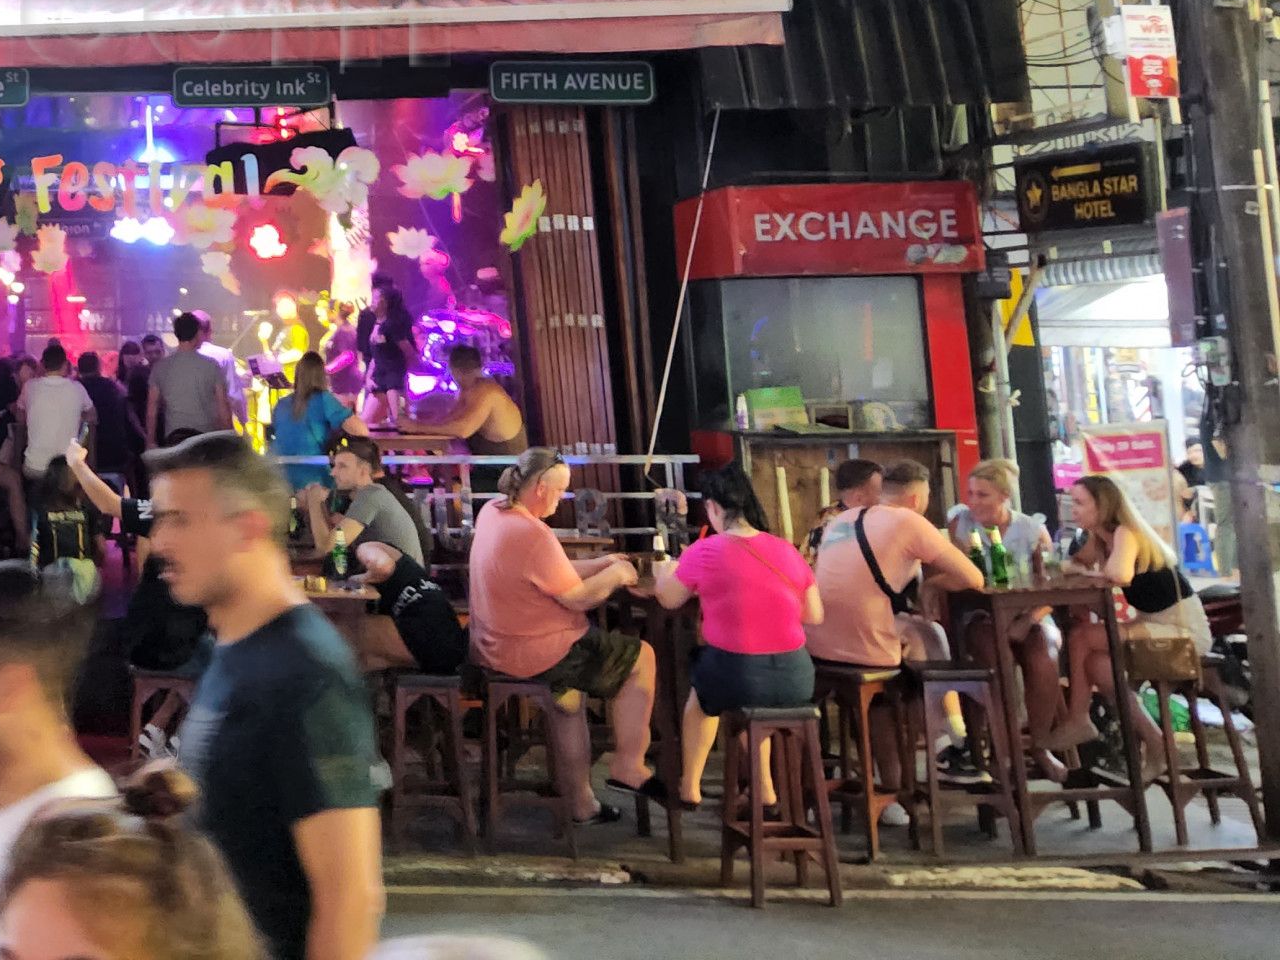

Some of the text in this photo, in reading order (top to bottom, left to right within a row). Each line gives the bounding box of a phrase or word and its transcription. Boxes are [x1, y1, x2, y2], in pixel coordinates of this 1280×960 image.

[5, 71, 19, 83] St
[182, 72, 321, 100] Celebrity Ink St
[500, 71, 645, 90] FIFTH AVENUE
[1051, 174, 1138, 202] BANGLA STAR
[1073, 199, 1116, 220] HOTEL
[753, 208, 959, 242] EXCHANGE
